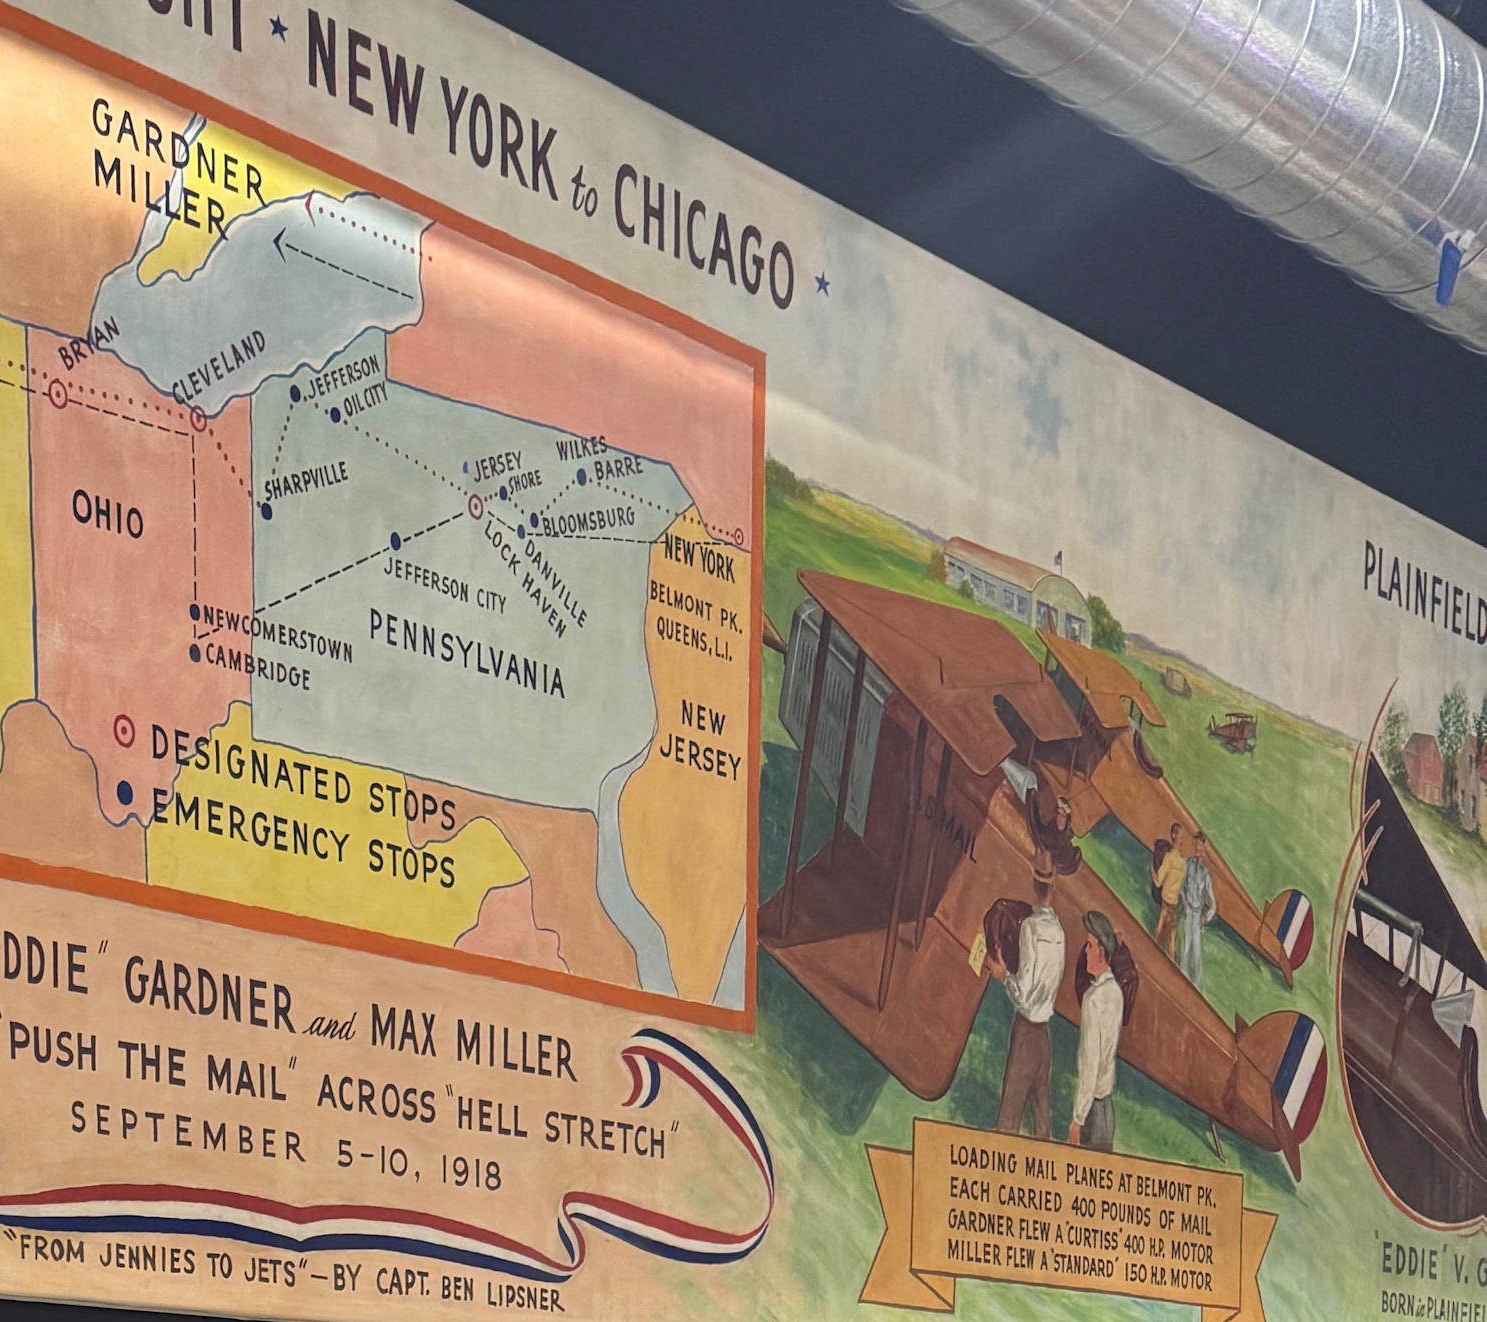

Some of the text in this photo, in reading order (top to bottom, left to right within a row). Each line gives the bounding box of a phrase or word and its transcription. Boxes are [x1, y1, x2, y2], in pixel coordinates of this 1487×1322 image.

[91, 98, 268, 208] GARDNER
[308, 8, 424, 135] NEW
[439, 75, 558, 201] YORK
[571, 163, 598, 219] to
[614, 162, 795, 310] CHICAGO
[94, 149, 229, 241] MILLER
[57, 316, 121, 371] BRYAN
[172, 330, 266, 404] CLEVELAND
[308, 354, 381, 400] JEFFERSON
[343, 381, 388, 417] OIL CITY
[473, 450, 522, 483] JERSEY
[556, 435, 608, 462] WILKES
[594, 455, 644, 480] BARRE
[264, 461, 349, 501] SHARPVILLE
[508, 469, 543, 495] SHORE
[72, 489, 143, 539] OHIO
[542, 506, 636, 537] BLOOMSBURG
[384, 556, 507, 616] JEFFERSON CITY
[484, 520, 567, 639] LOCK HAVEN
[524, 538, 588, 629] DANVILLE
[664, 532, 736, 584] NEW YORK
[204, 603, 353, 664] NEWCOMERSTOWN
[650, 579, 743, 635] BELMONT PK.
[369, 607, 565, 699] PENNSYLVANIA
[656, 616, 712, 657] QUEENS,
[205, 643, 310, 691] CAMBRIDGE
[681, 698, 726, 736] NEW
[151, 723, 457, 831] DESIGNATED STOPS
[659, 733, 741, 781] JERSEY
[153, 787, 455, 889] EMERGENCY STOPS
[124, 955, 295, 1033] GARDNER
[301, 1010, 356, 1042] and
[370, 1003, 437, 1058] MAX
[456, 1018, 578, 1083] MILLER
[117, 1039, 186, 1088] THE
[317, 1072, 436, 1124] ACROSS
[70, 1099, 503, 1192] SEPTEMBER 5-10, 1918
[950, 1144, 1217, 1209] LOADING MAIL PLANES AT BELMONT PK.
[950, 1176, 1211, 1236] EACH CARRIED 400 POUNDS OF MAIL
[947, 1209, 1014, 1237] GARDNER
[1019, 1218, 1051, 1242] FLEW
[1055, 1224, 1064, 1245] A
[1124, 1234, 1145, 1255] 400
[1171, 1240, 1213, 1265] MOTOR
[947, 1239, 1001, 1266] MILLER
[1006, 1246, 1035, 1270] FLEW
[1040, 1251, 1048, 1271] A
[1125, 1262, 1147, 1283] 150
[1170, 1268, 1212, 1291] MOTOR
[99, 1241, 196, 1275] JENNIES
[207, 1251, 232, 1279] TO
[376, 1268, 430, 1297] CAPT.
[441, 1276, 474, 1302] BEN
[487, 1282, 565, 1312] LIPSNER
[1454, 1254, 1469, 1284] V.
[1381, 1290, 1414, 1317] BORN
